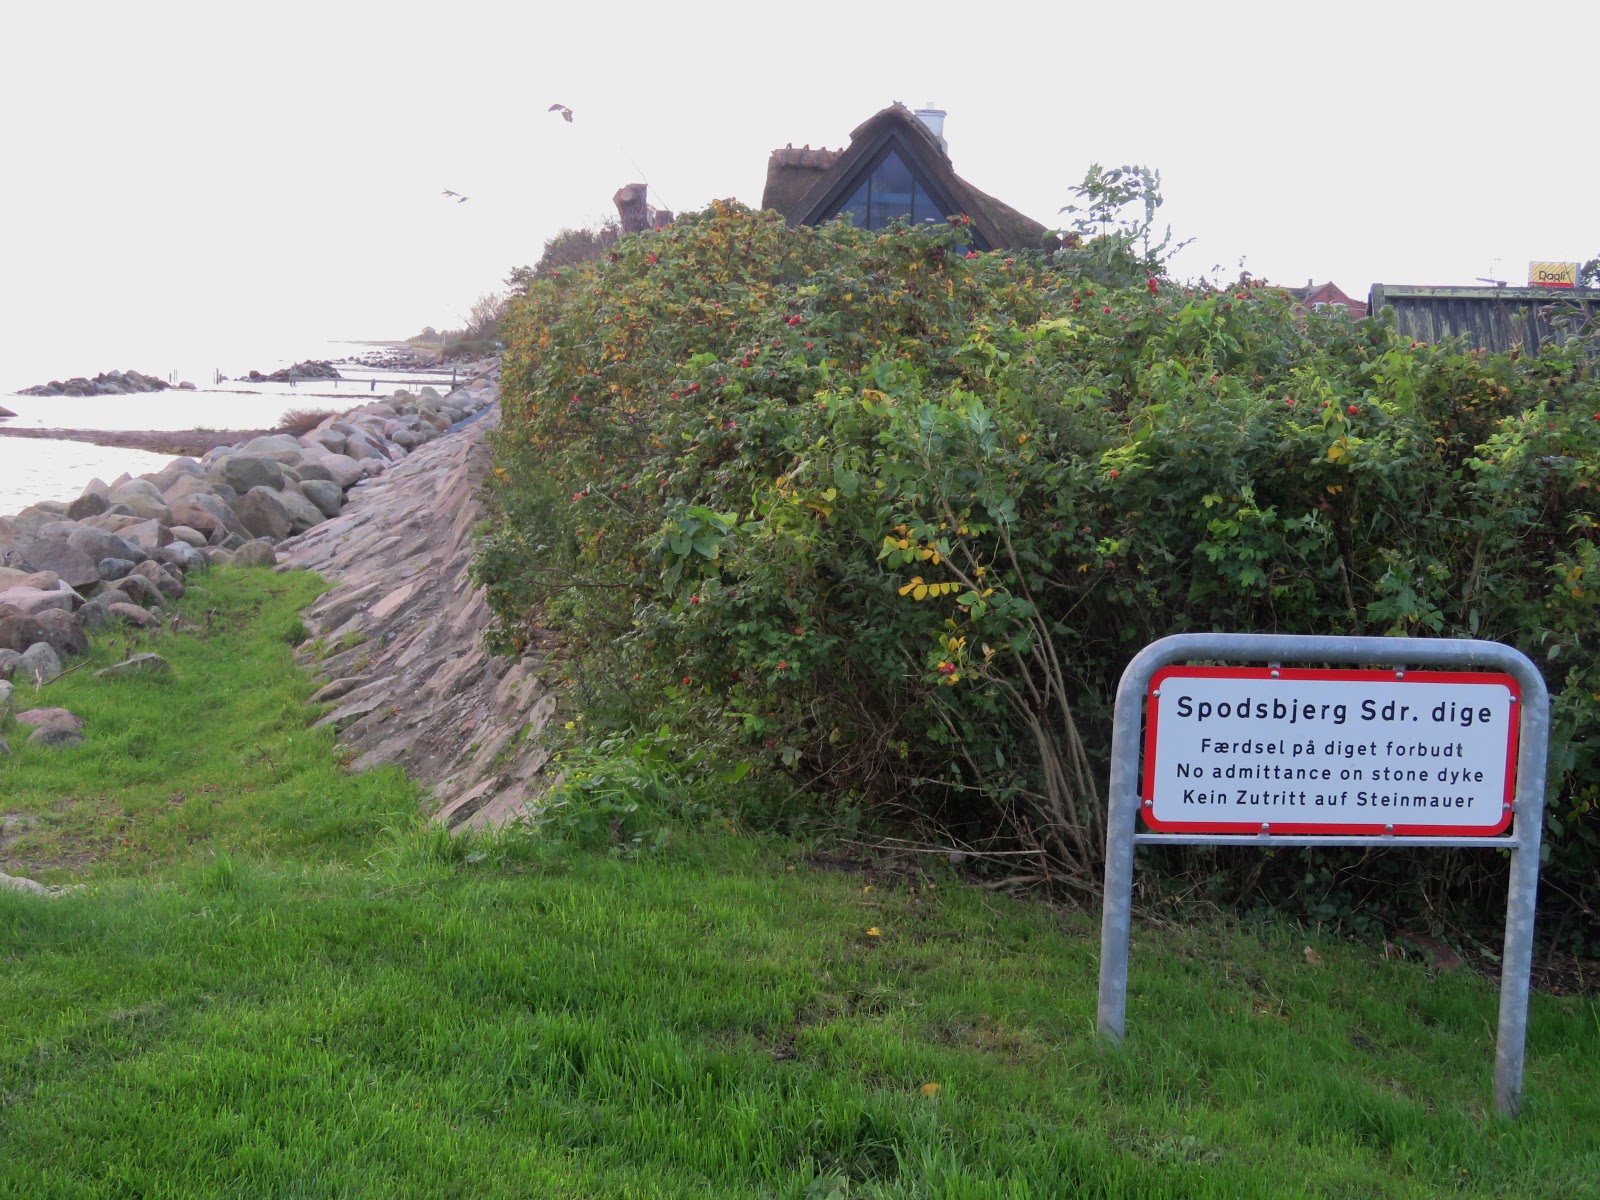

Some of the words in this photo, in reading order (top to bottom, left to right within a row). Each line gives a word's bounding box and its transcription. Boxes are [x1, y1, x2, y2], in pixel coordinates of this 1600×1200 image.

[1177, 696, 1347, 724] Spodsbjerg
[1360, 699, 1419, 722] Sdr.
[1431, 701, 1492, 727] dige
[1201, 738, 1285, 755] Færdsel
[1292, 739, 1316, 758] på
[1324, 741, 1377, 759] diget
[1386, 742, 1463, 758] forbudt
[1176, 763, 1204, 779] No
[1212, 763, 1331, 780] admittance
[1340, 769, 1363, 781] on
[1371, 767, 1429, 782] stone
[1437, 767, 1484, 785] dyke
[1183, 789, 1227, 805] Kein
[1236, 789, 1306, 806] Zutritt
[1314, 791, 1348, 806] auf
[1356, 791, 1474, 808] Steinmauer
